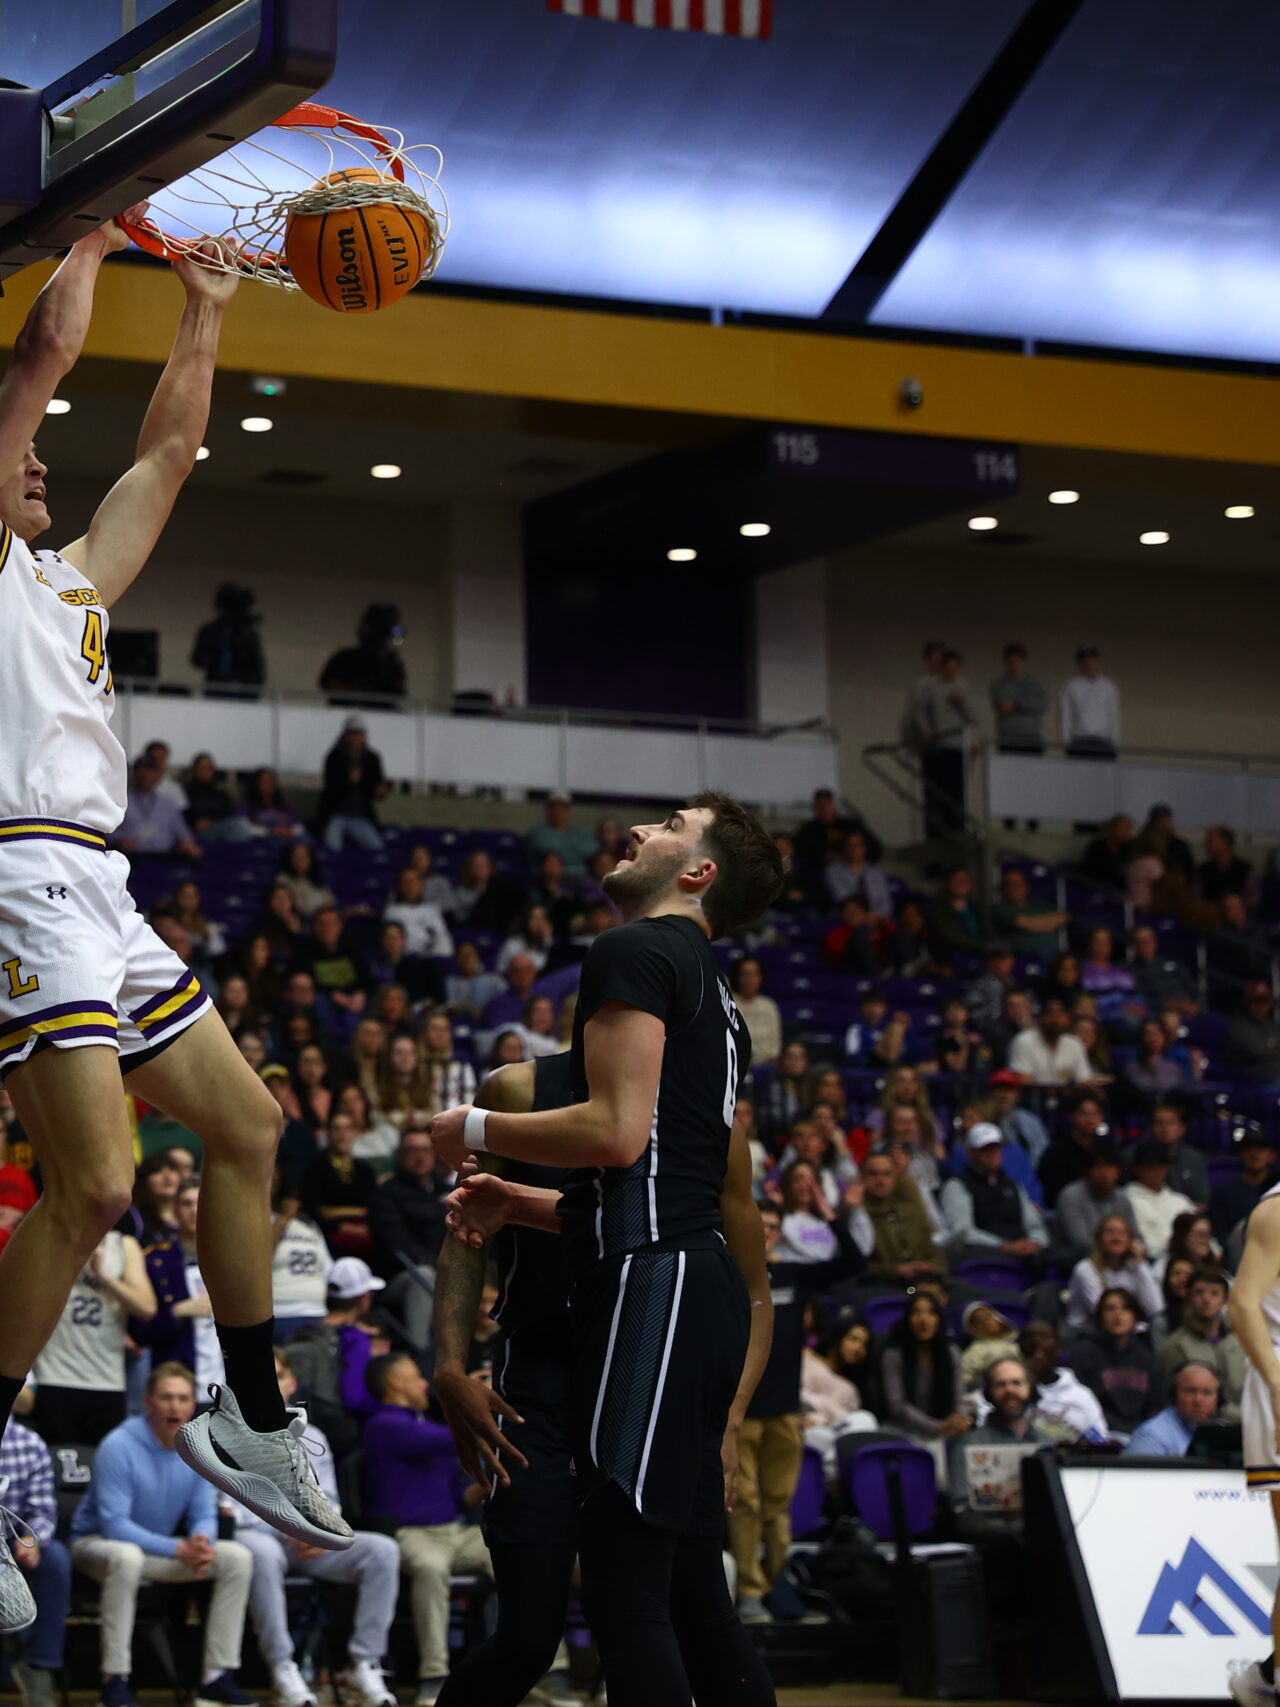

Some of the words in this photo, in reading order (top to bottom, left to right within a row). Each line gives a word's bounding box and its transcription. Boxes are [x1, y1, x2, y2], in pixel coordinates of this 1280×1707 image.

[335, 226, 368, 311] Wilson
[773, 432, 819, 465] 115
[974, 450, 1017, 482] 114
[2, 956, 40, 1000] L
[72, 1295, 103, 1327] 22
[56, 1448, 92, 1483] L
